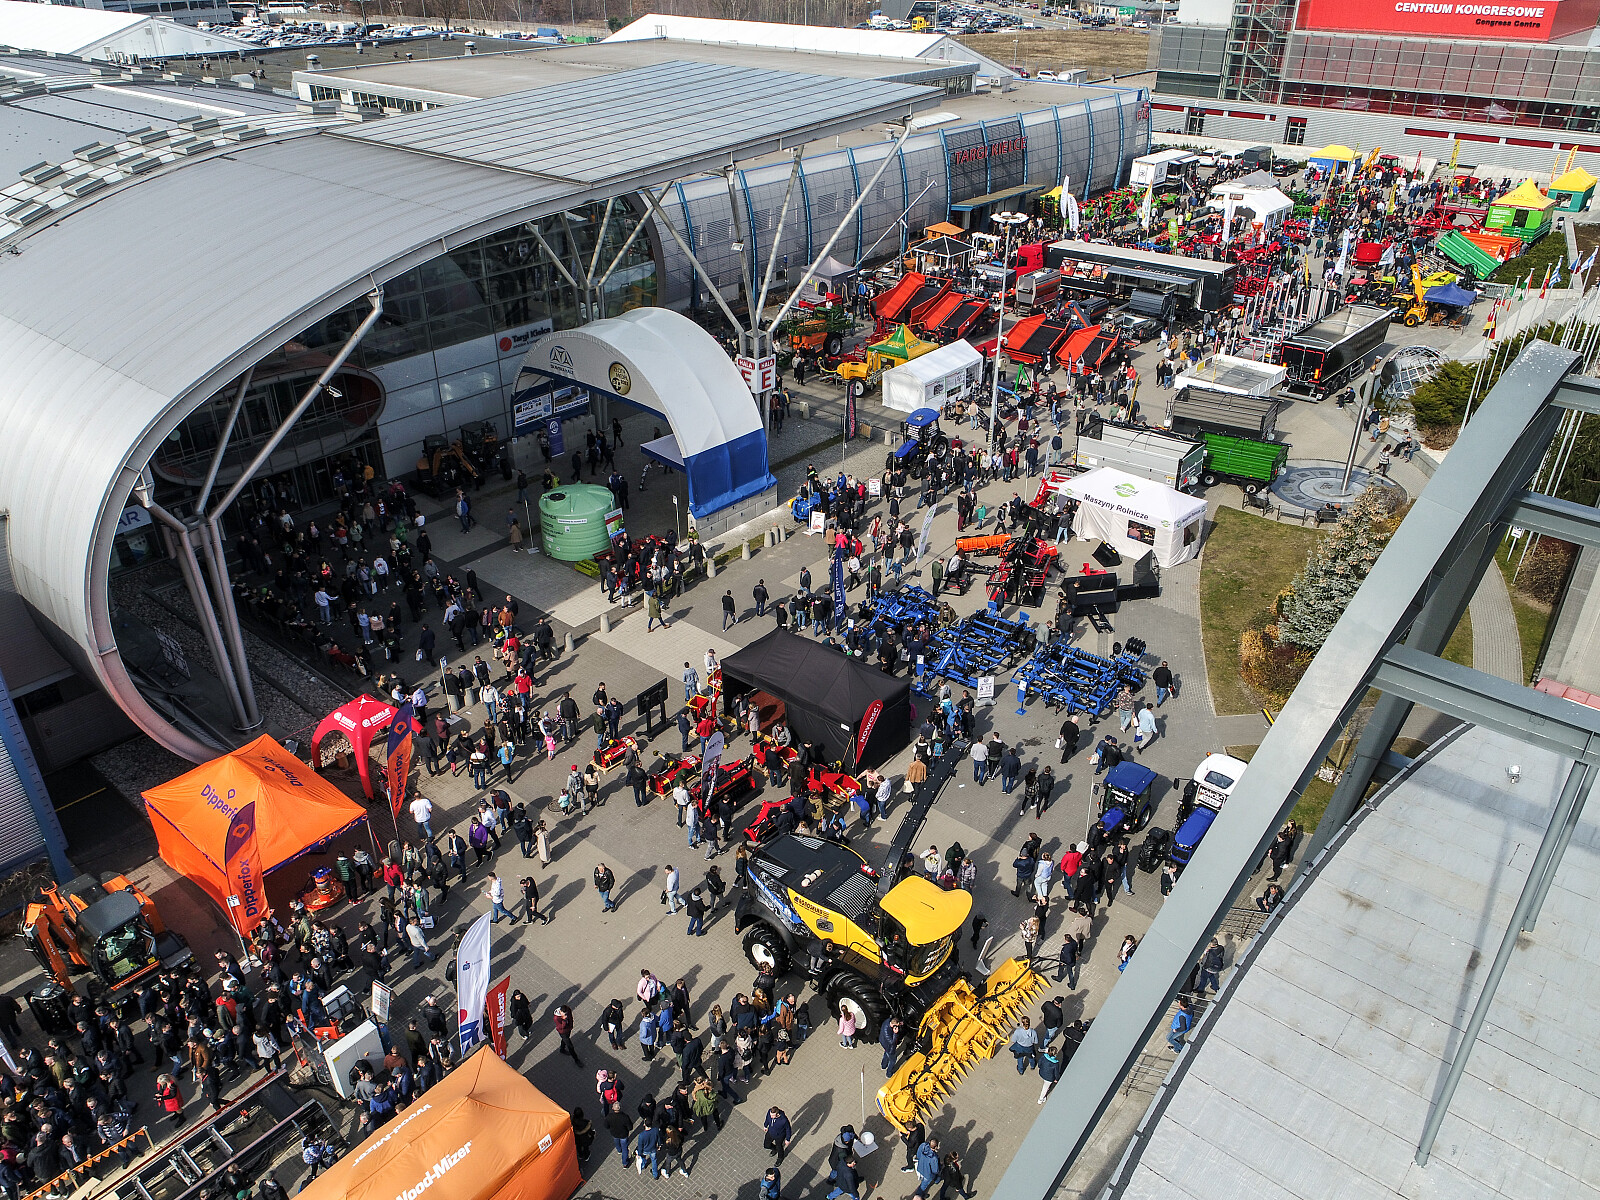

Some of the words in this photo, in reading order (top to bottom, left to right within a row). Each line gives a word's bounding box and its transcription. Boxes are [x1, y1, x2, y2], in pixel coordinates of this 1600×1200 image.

[1395, 2, 1452, 14] CENTRUM
[1455, 4, 1545, 18] KONGRESOWE
[1475, 18, 1512, 27] Congress
[1513, 20, 1541, 28] Centre
[955, 145, 988, 165] TARGI
[991, 136, 1027, 156] KIELCE
[512, 332, 529, 342] Targi
[531, 327, 551, 338] Kielce
[761, 360, 774, 369] HALA
[762, 369, 772, 389] E
[1083, 493, 1116, 511] Maszyny
[1116, 504, 1149, 521] Rolnicze
[200, 784, 237, 821] Dipperf
[238, 858, 259, 918] Dipperfox
[352, 1104, 432, 1167] Wood-Mizer
